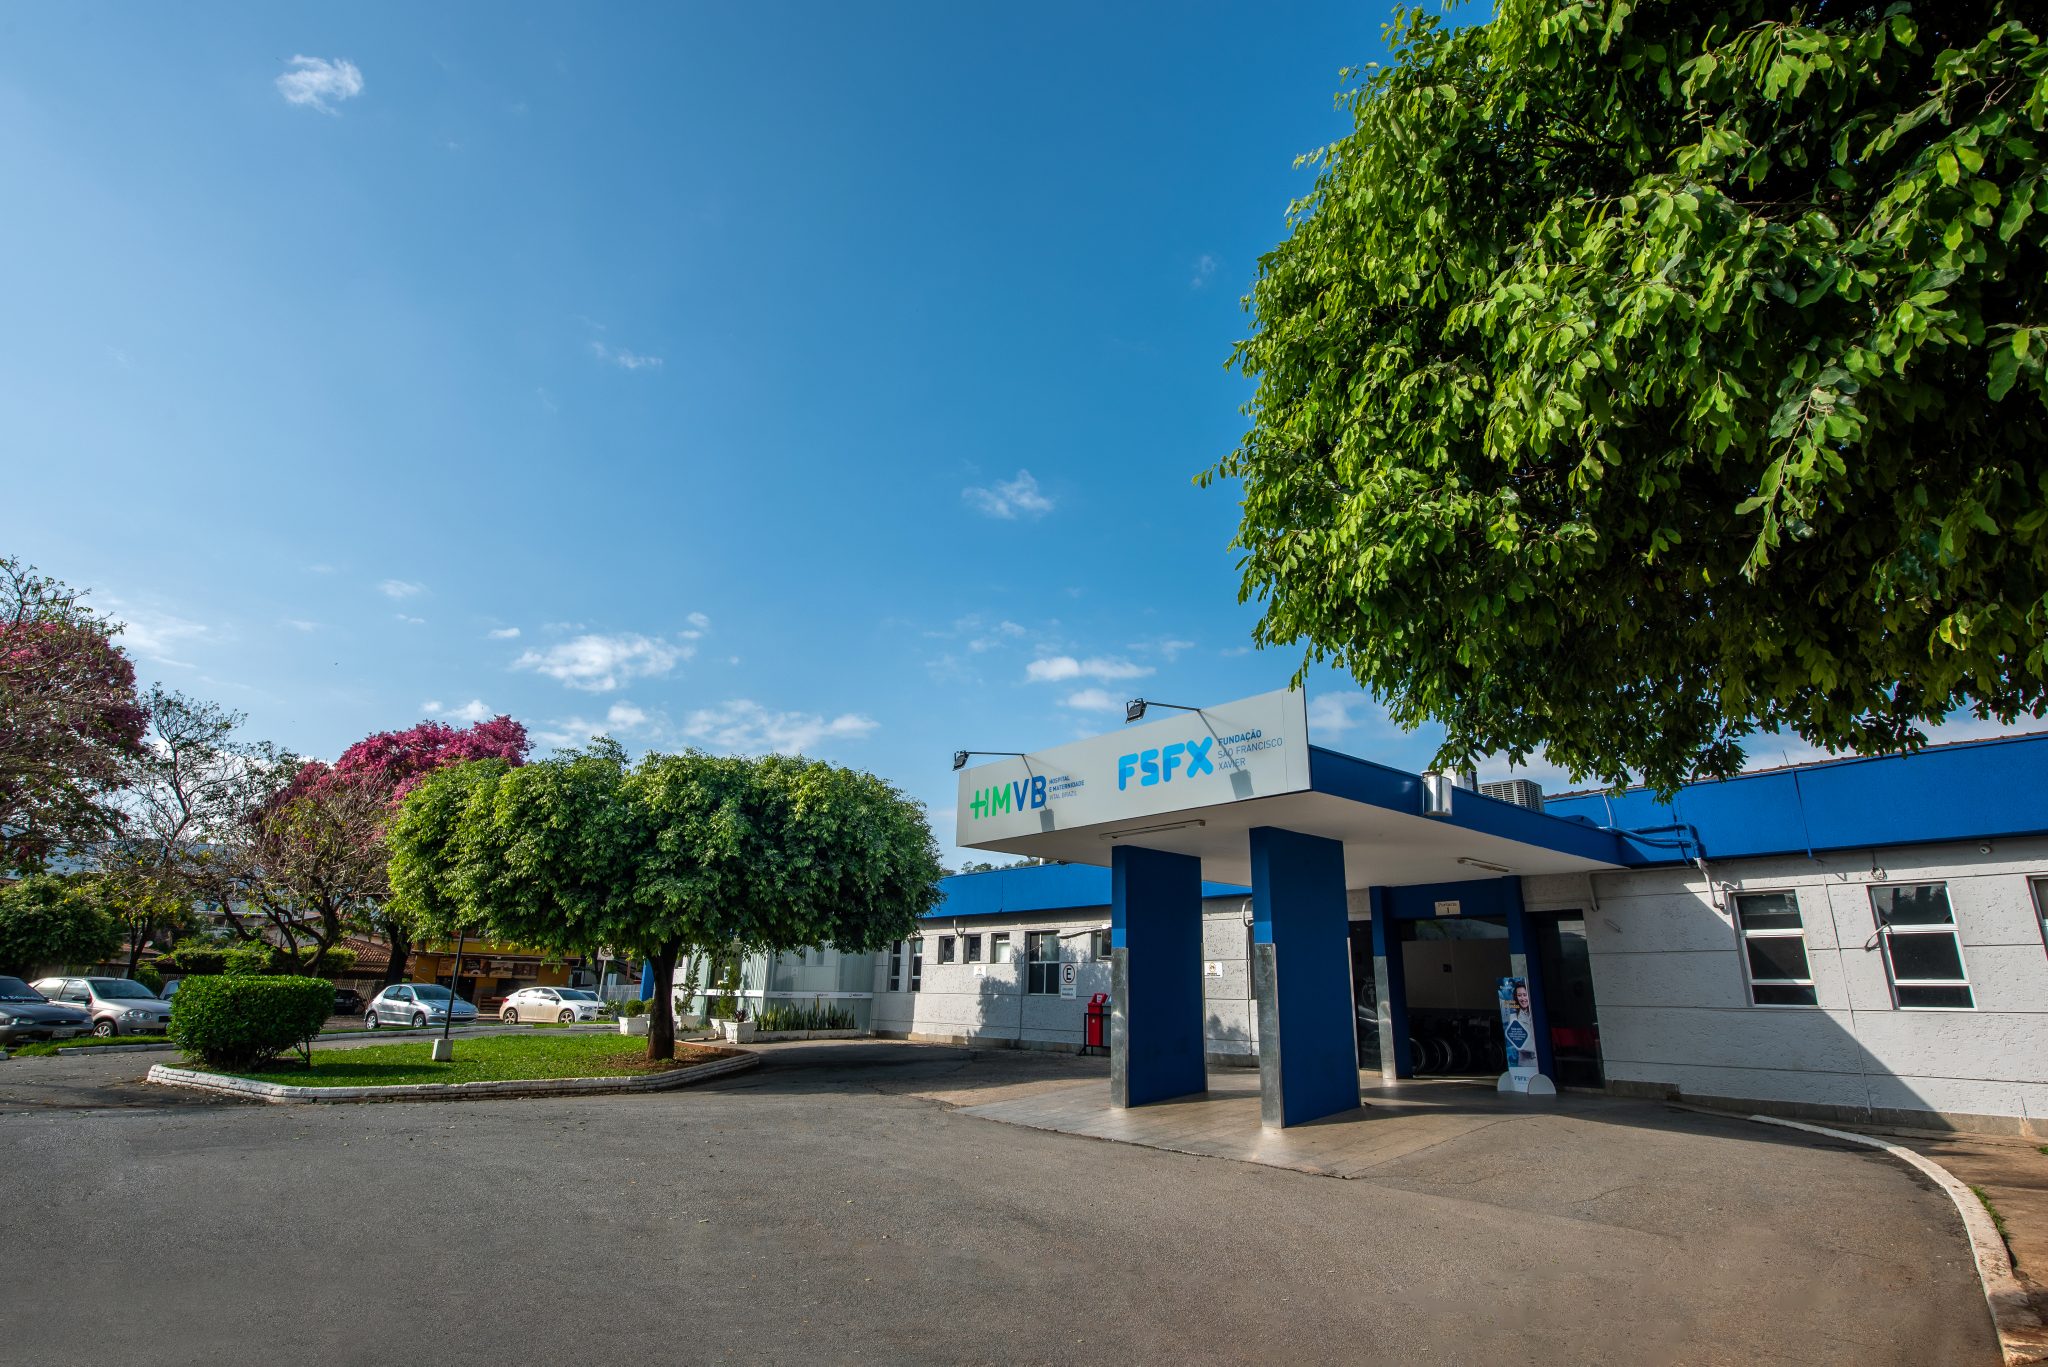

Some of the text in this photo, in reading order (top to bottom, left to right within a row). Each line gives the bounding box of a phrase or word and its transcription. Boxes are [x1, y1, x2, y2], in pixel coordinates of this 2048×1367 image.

[1218, 729, 1262, 746] FUNDAÇÃO
[1236, 737, 1283, 755] FRANCISCO
[1118, 736, 1214, 791] FSFX
[1218, 757, 1246, 771] XAVIER
[970, 775, 1047, 820] HMVB
[1066, 967, 1072, 981] E
